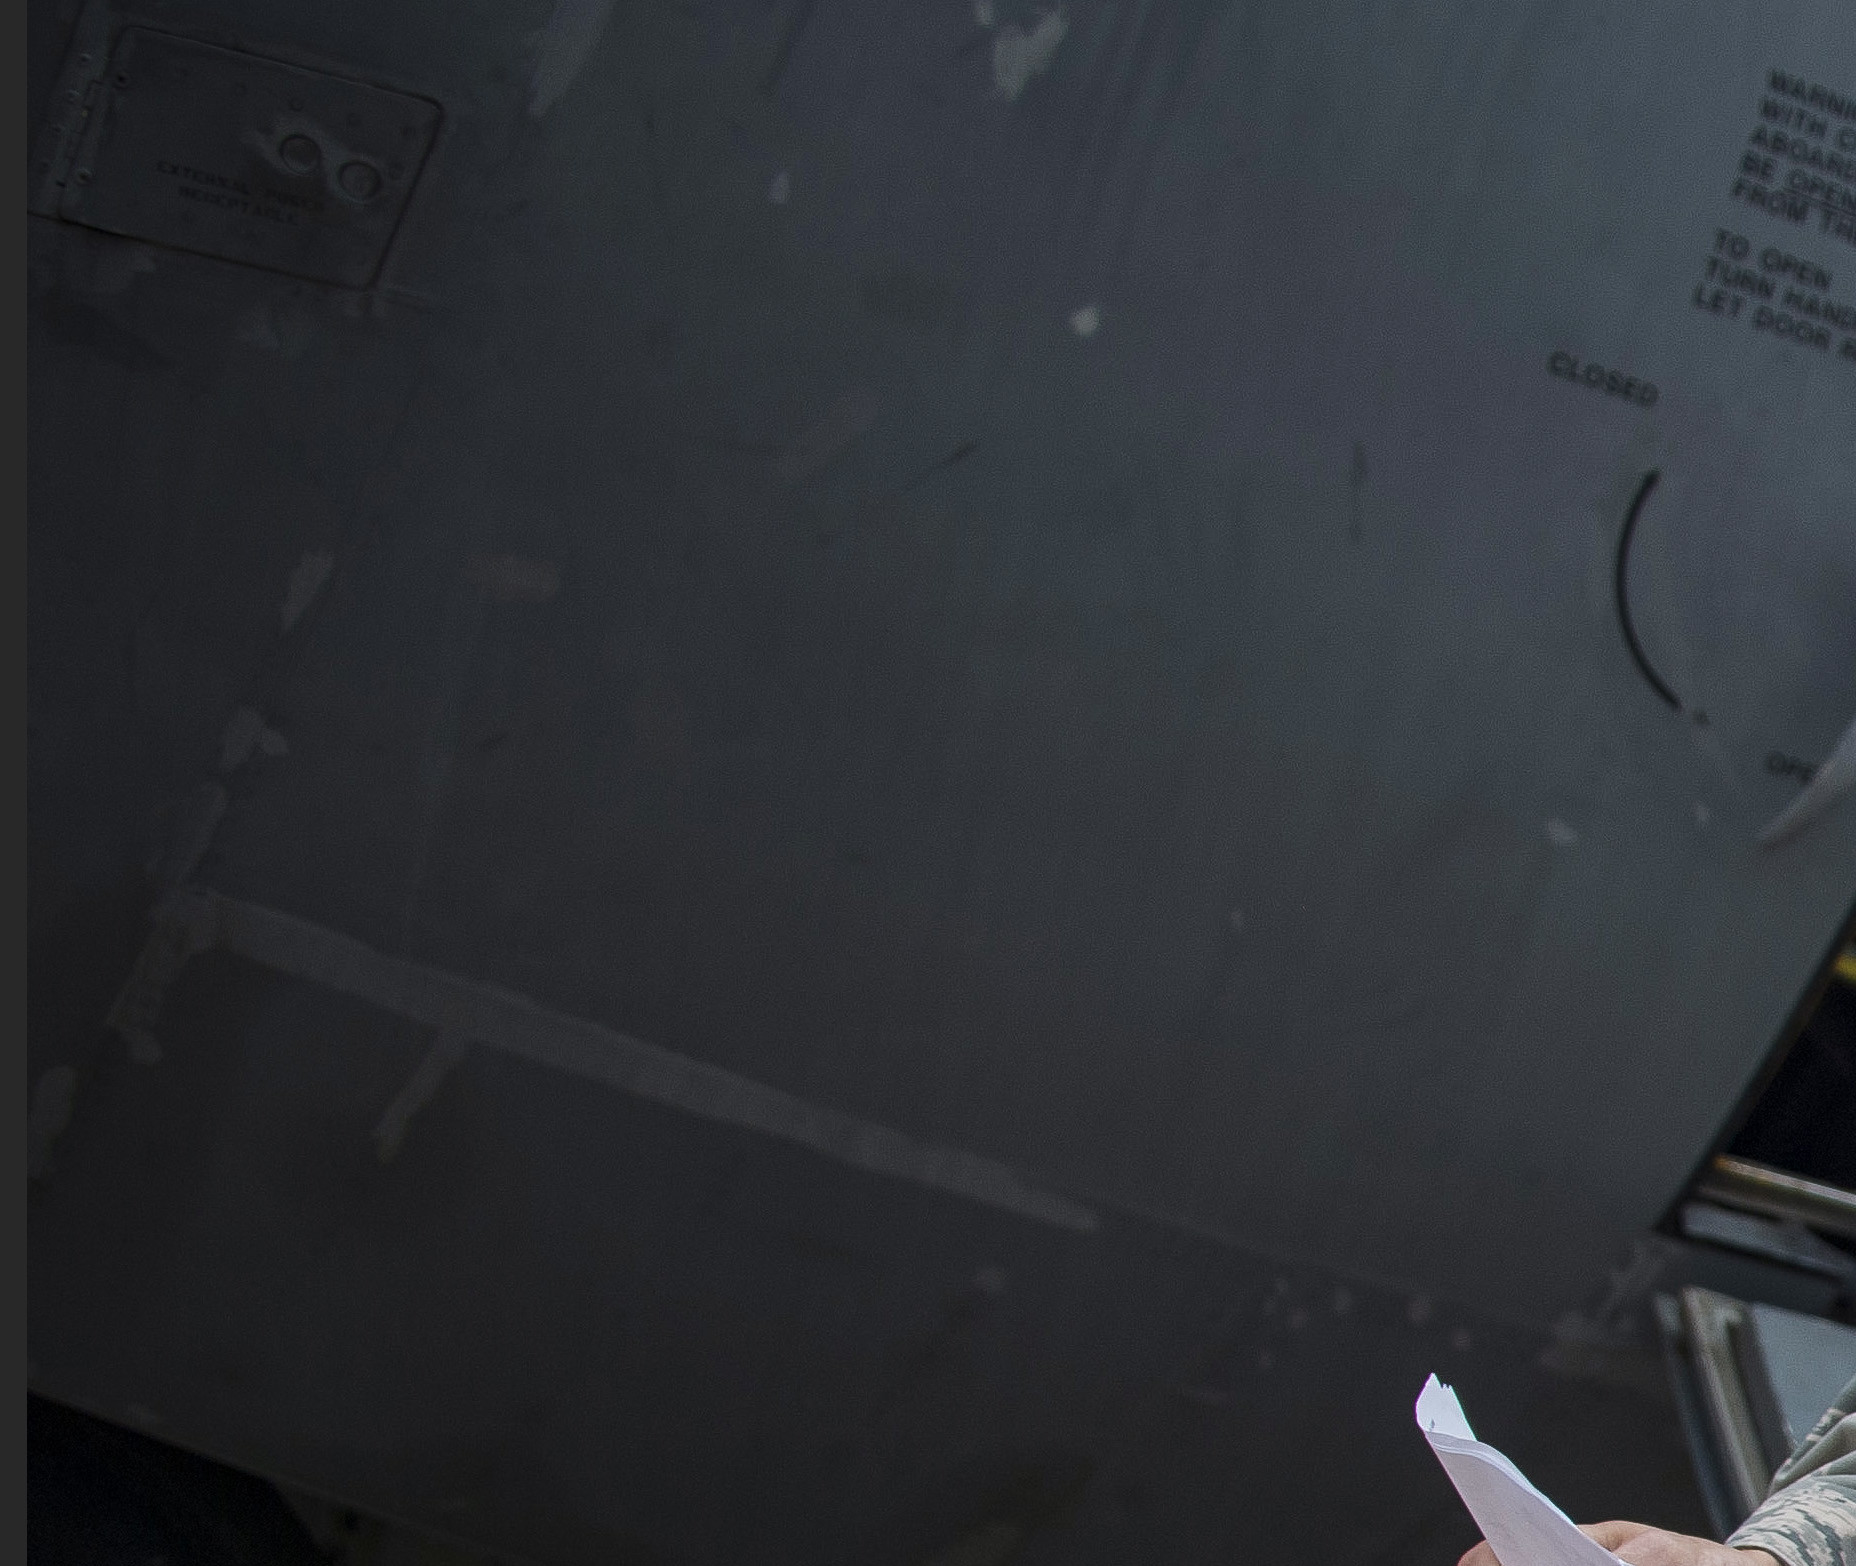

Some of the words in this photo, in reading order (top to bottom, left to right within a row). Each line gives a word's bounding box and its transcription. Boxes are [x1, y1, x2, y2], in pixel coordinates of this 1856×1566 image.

[1759, 98, 1827, 138] WITH
[1741, 148, 1776, 181] BE
[1728, 177, 1810, 224] FROM
[1706, 255, 1777, 300] TURN
[1713, 227, 1751, 261] TO
[1759, 246, 1832, 292] OPEN
[1691, 283, 1747, 319] LET
[1751, 305, 1832, 351] DOOR
[1545, 351, 1660, 408] CLOSED
